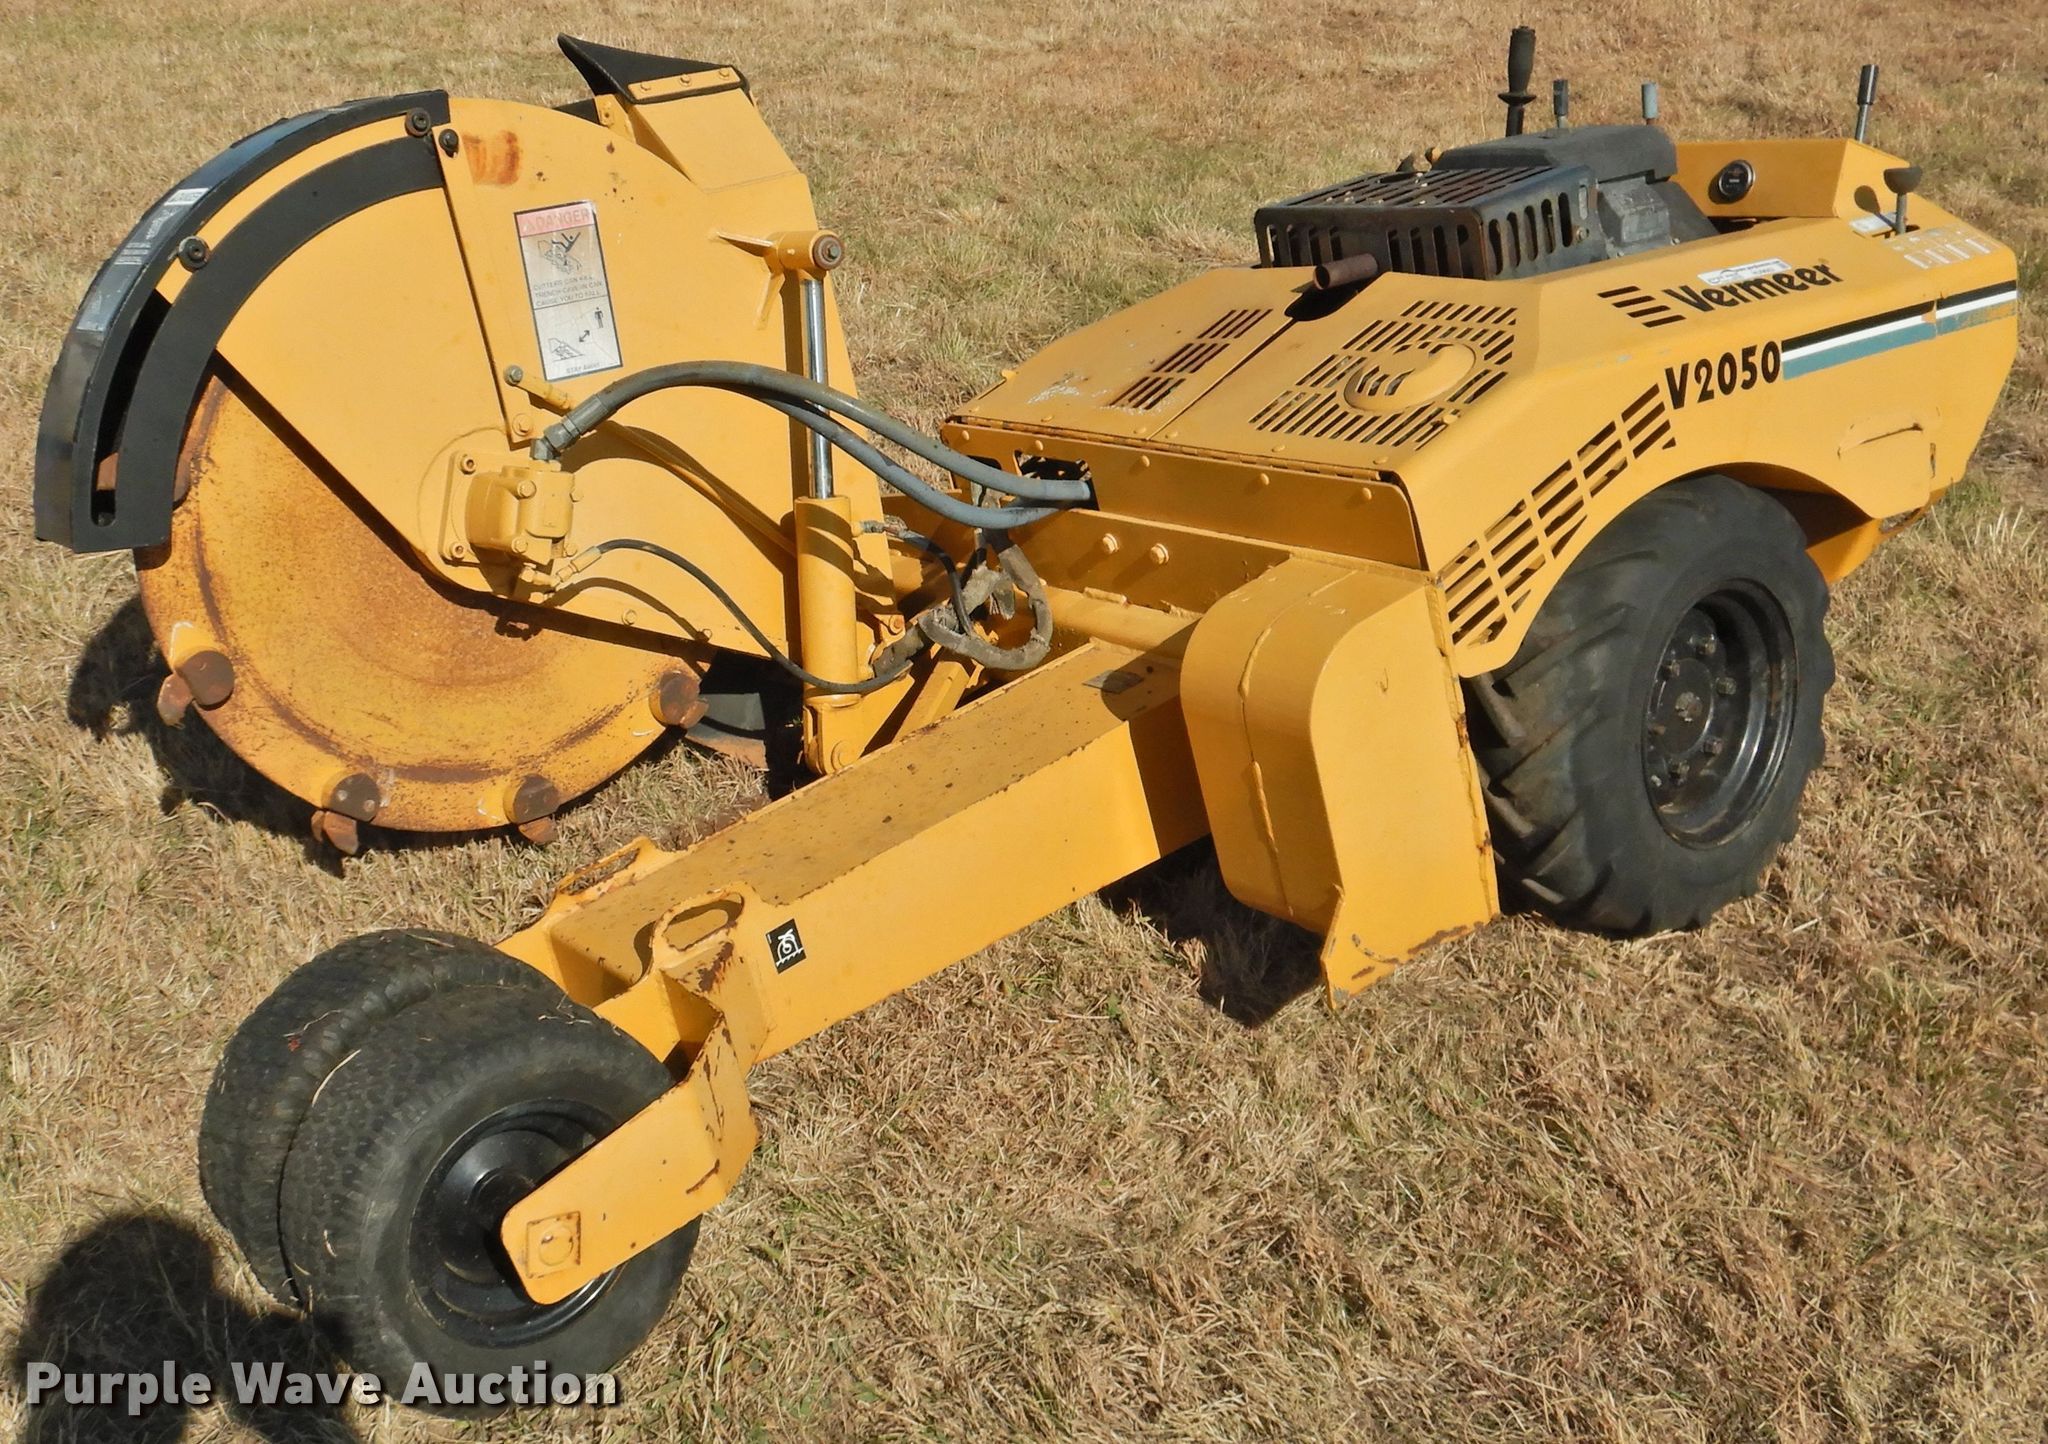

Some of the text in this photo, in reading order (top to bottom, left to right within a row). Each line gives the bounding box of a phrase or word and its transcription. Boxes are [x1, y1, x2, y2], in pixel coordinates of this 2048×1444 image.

[535, 208, 590, 226] DANGER
[1662, 264, 1843, 312] Vermeer
[1665, 341, 1781, 410] V2050
